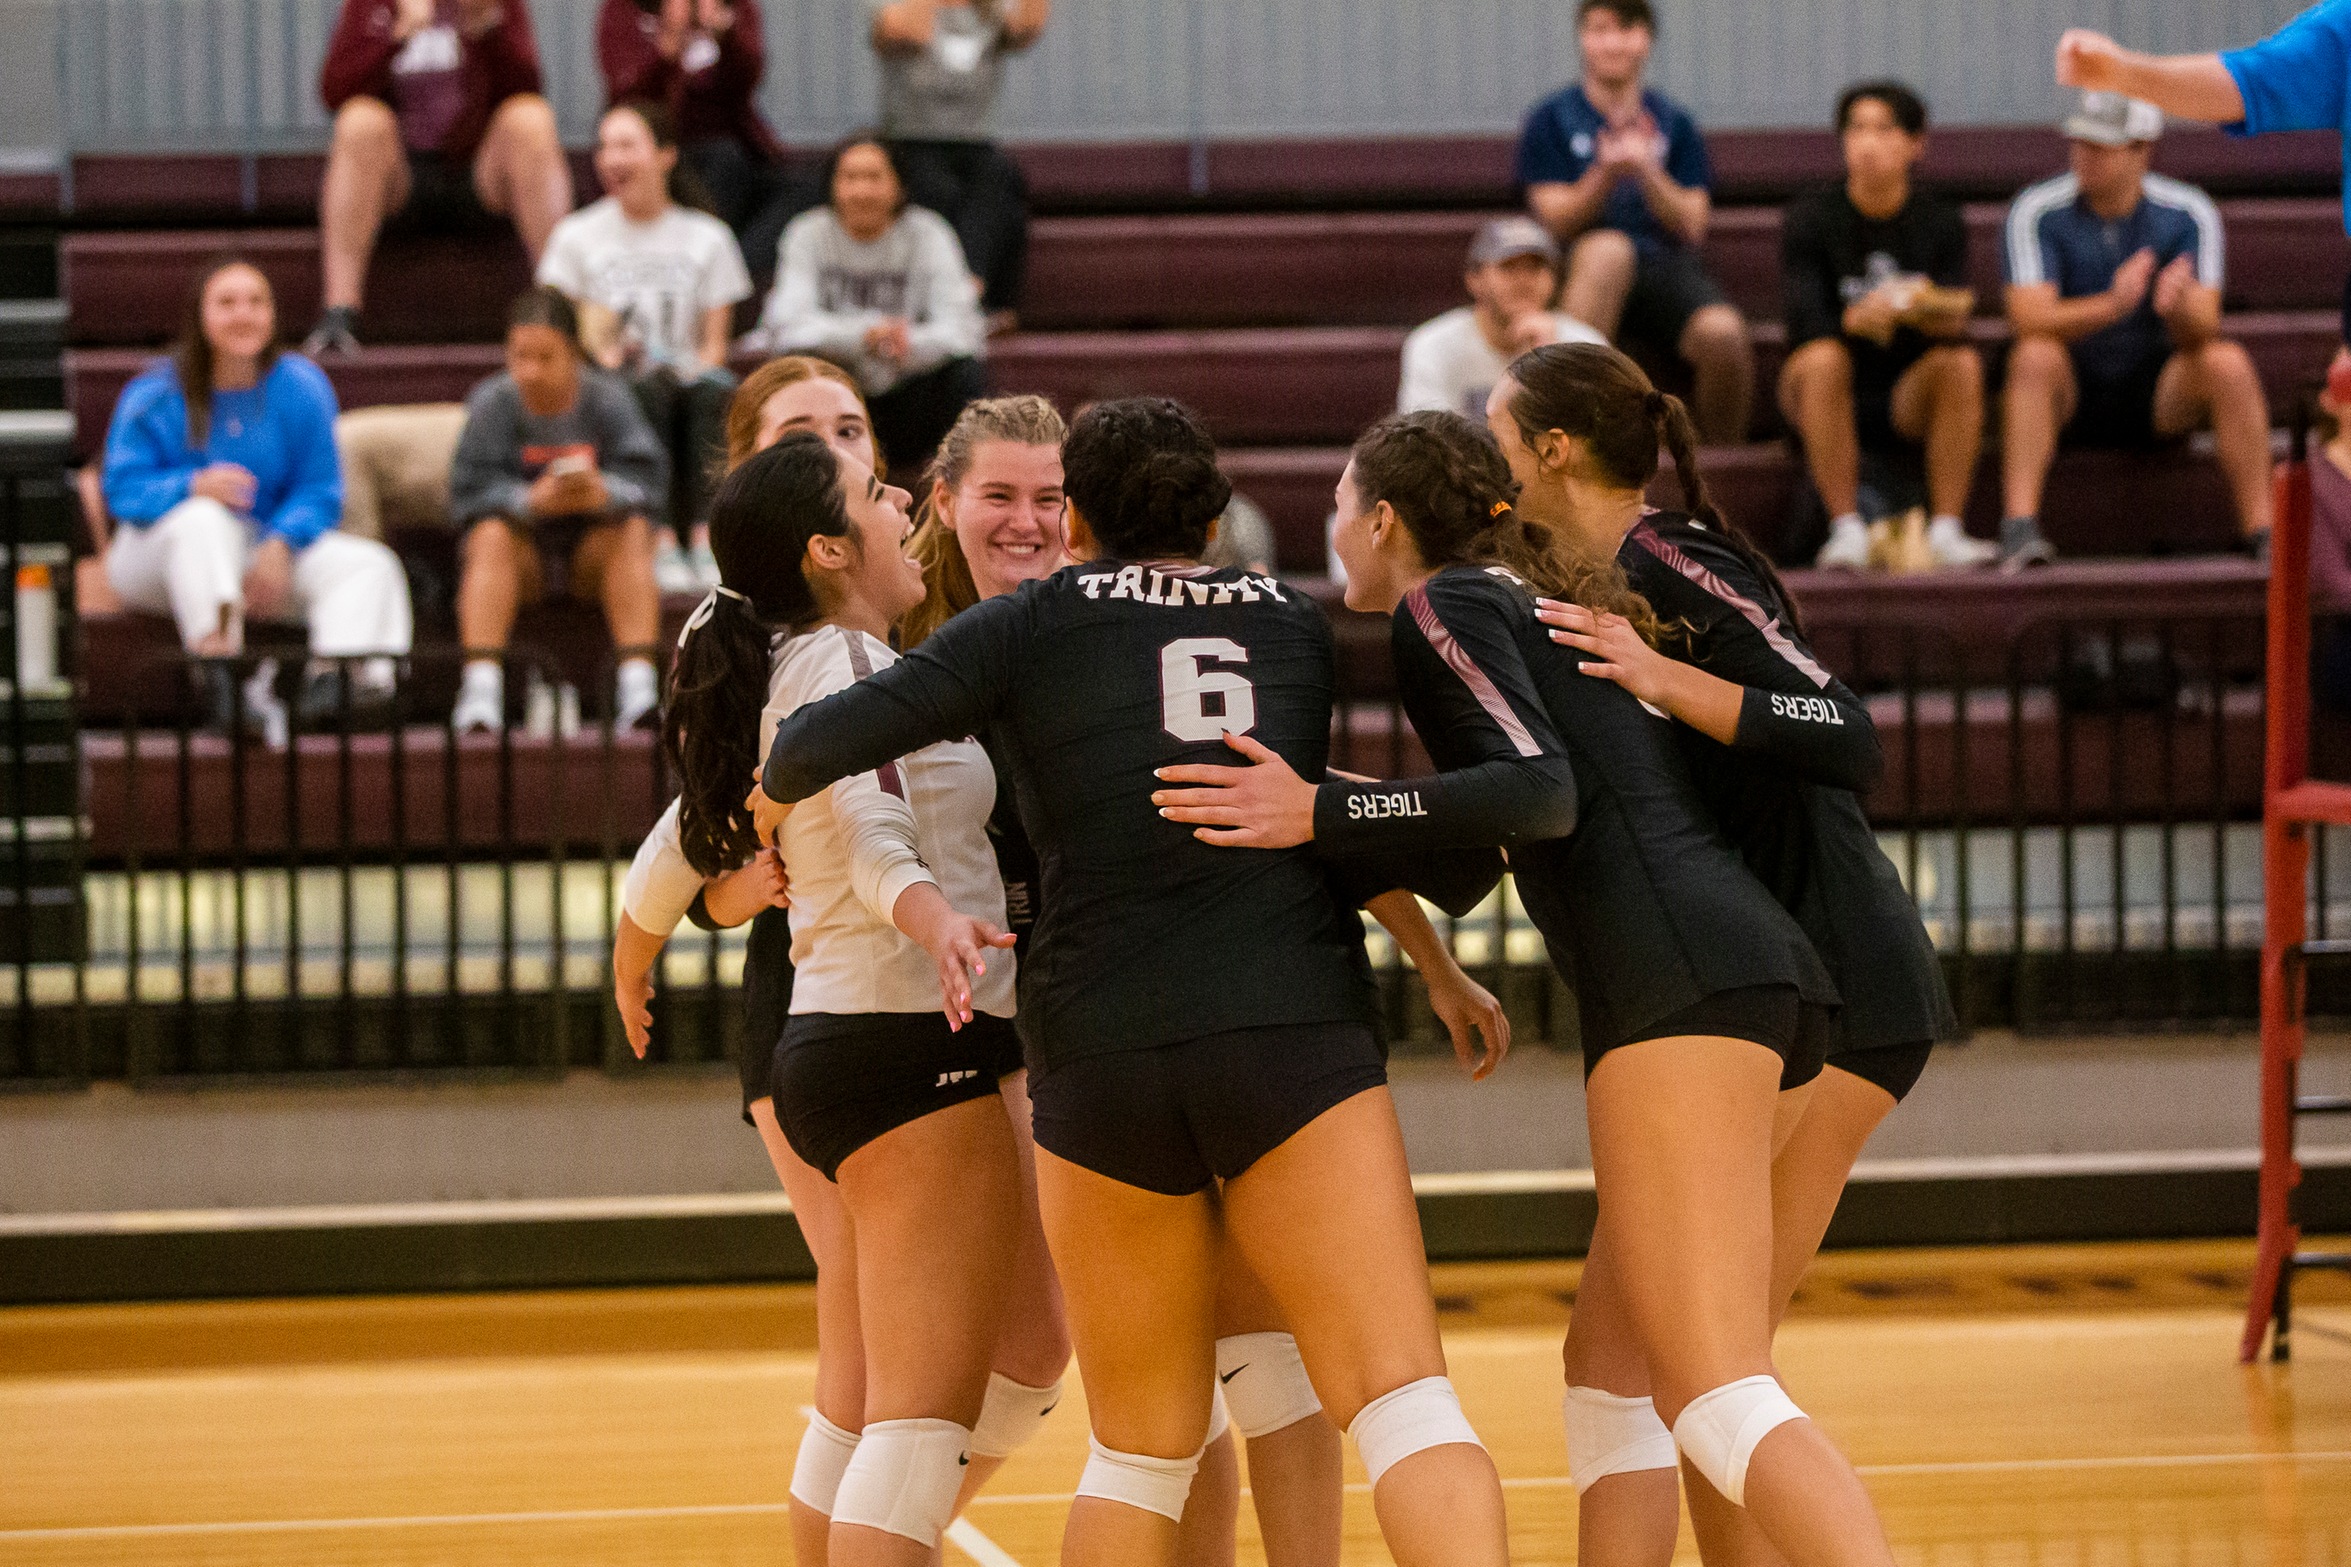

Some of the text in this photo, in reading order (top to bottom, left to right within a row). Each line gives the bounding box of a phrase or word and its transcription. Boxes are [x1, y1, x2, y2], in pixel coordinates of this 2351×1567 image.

[1077, 565, 1288, 606] TRINITY
[1158, 636, 1259, 744] 6
[1770, 692, 1845, 726] TIGERS
[1347, 790, 1428, 820] TIGERS
